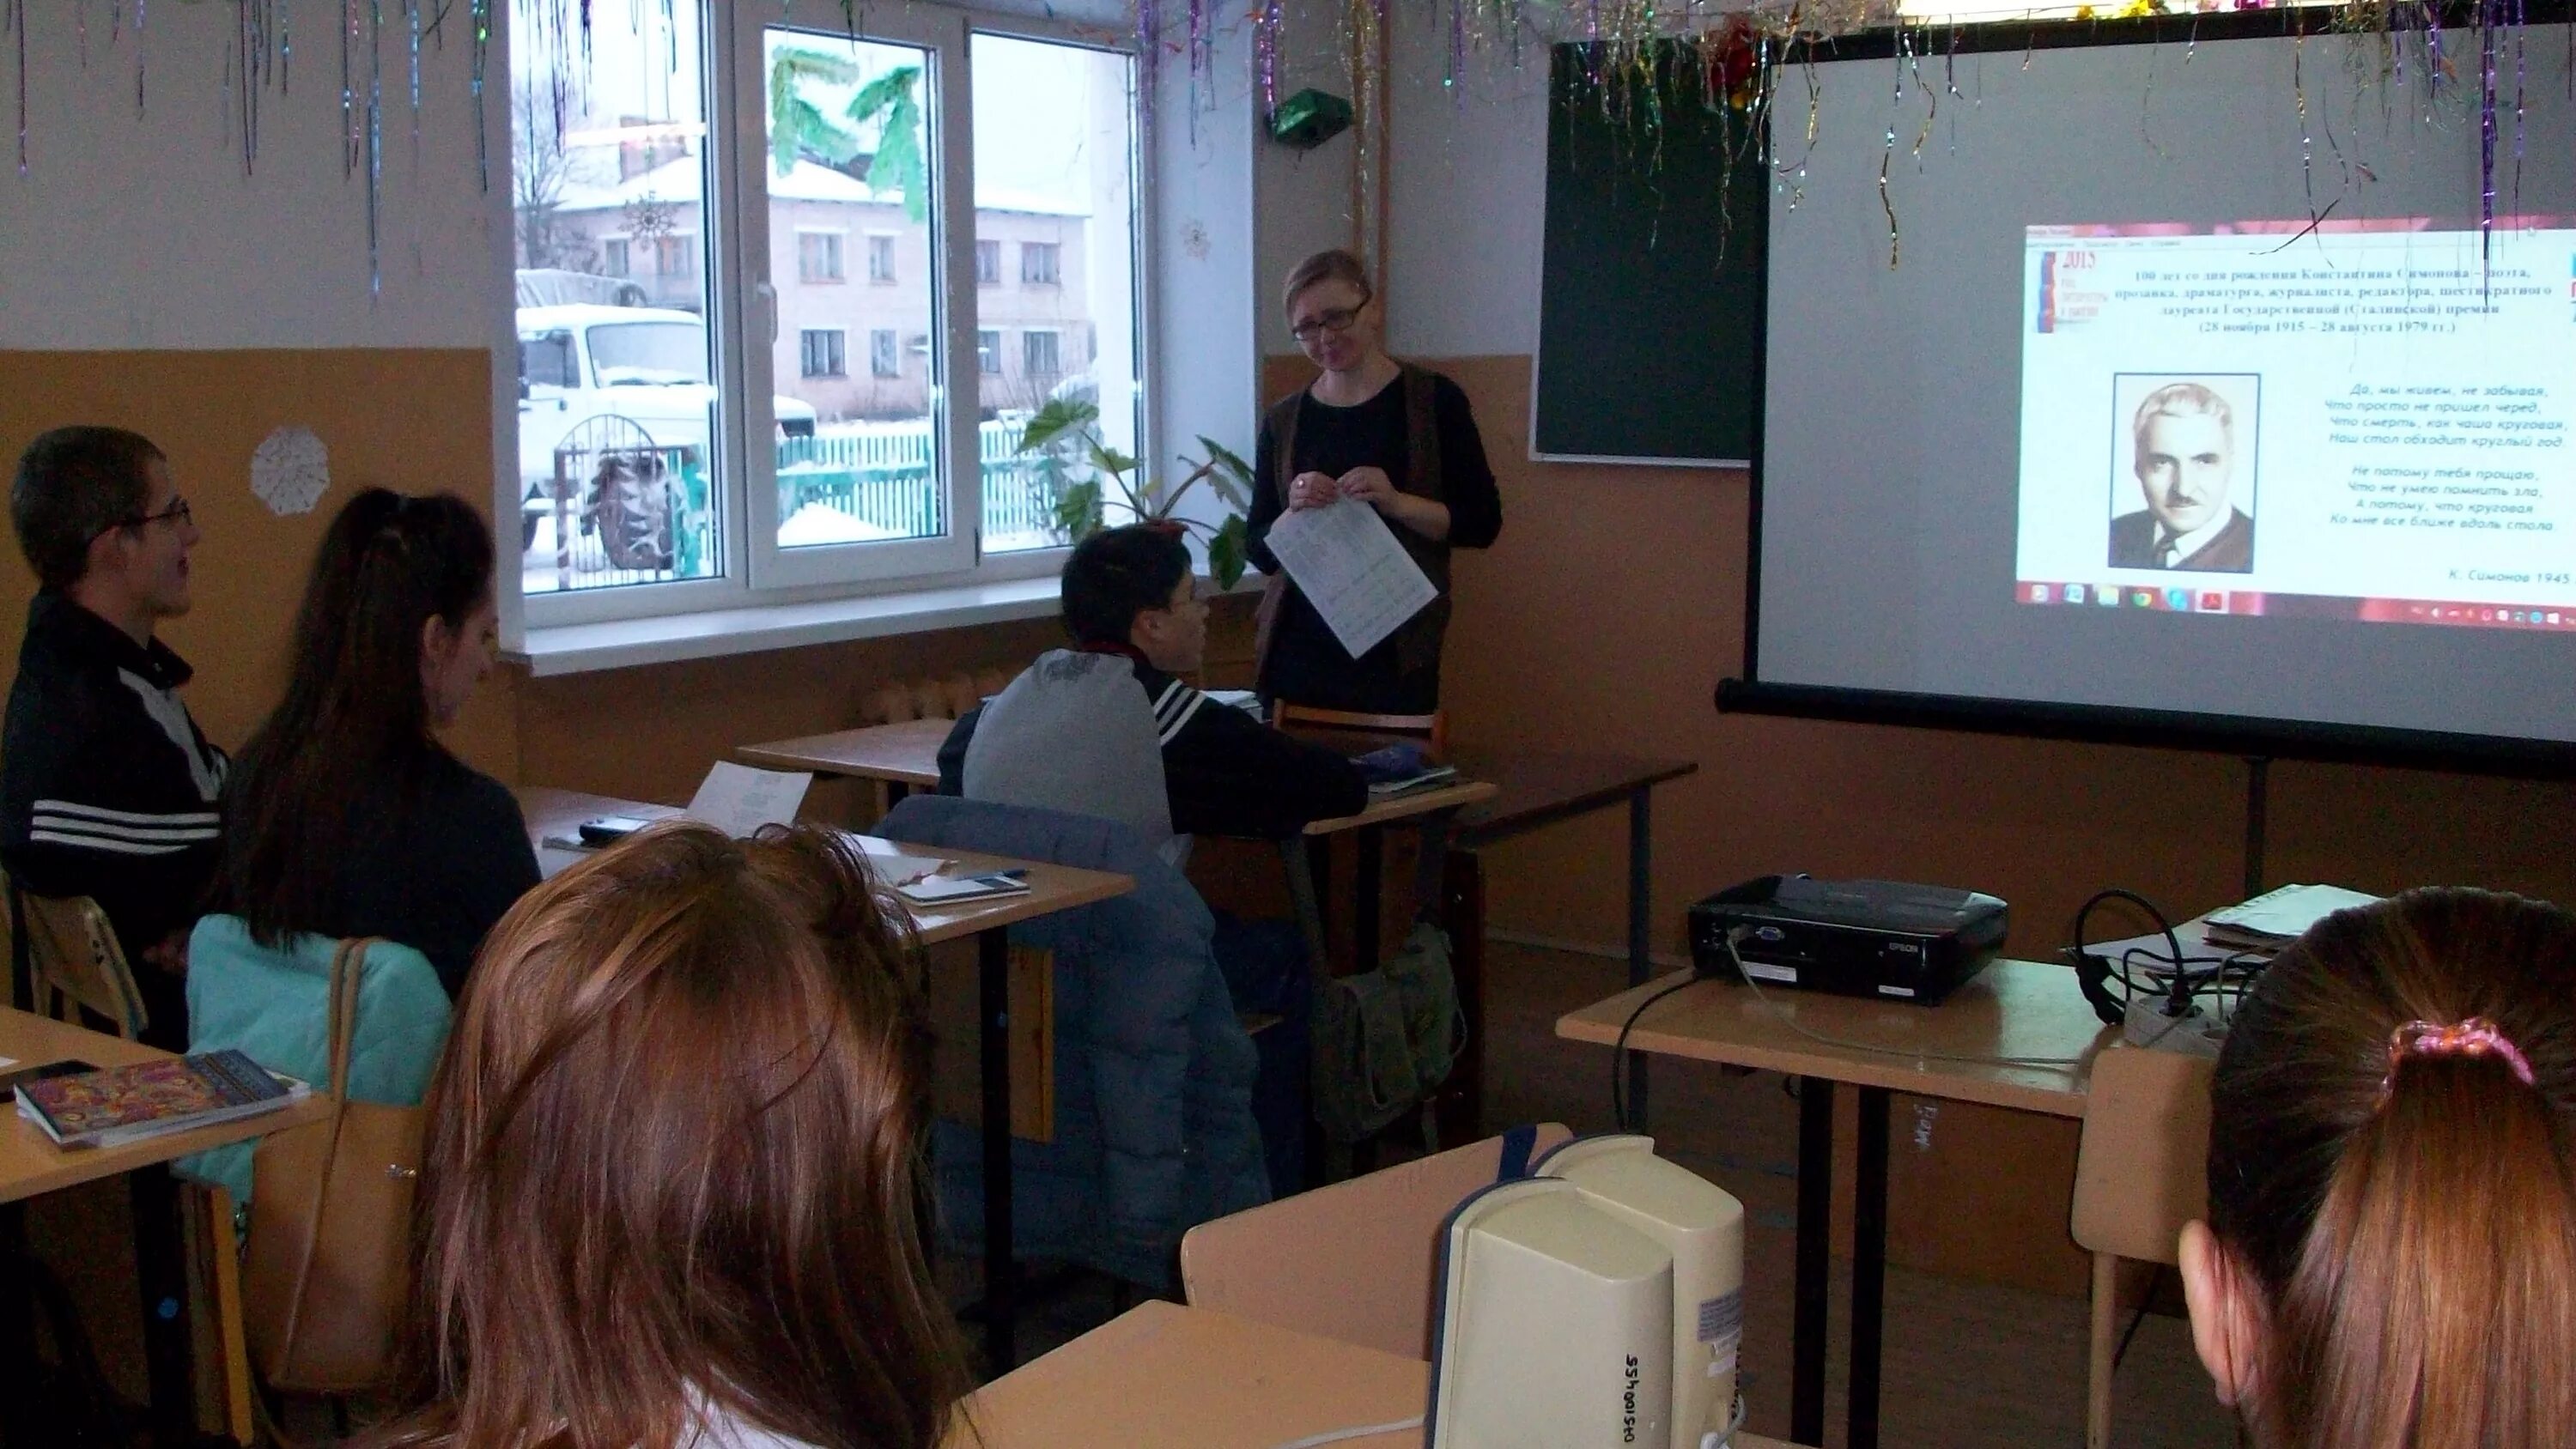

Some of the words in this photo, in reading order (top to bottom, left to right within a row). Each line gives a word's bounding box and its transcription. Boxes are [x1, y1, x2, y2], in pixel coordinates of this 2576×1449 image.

[2063, 251, 2095, 269] 2015
[2135, 271, 2156, 281] 100
[2301, 269, 2392, 280] Константина
[2397, 269, 2470, 278] Симонова
[2269, 288, 2354, 299] журналиста,
[2359, 288, 2434, 299] редактора,
[2224, 304, 2340, 317] Государственной
[2223, 322, 2270, 334] ноября
[2275, 321, 2305, 331] 1915
[2321, 321, 2336, 331] 28
[2340, 324, 2391, 335] августа
[2398, 321, 2428, 332] 1979
[2483, 385, 2549, 397] забывая,
[2324, 399, 2353, 410] Что
[2357, 403, 2409, 413] просто
[2330, 416, 2358, 426] Что
[2362, 419, 2421, 429] смерть,
[2427, 419, 2450, 427] как
[2457, 420, 2492, 428] чаша
[2497, 421, 2567, 433] круговая,
[2329, 433, 2359, 443] Наш
[2363, 435, 2399, 444] стол
[2403, 433, 2466, 445] обходит
[2472, 435, 2532, 448] круглый
[2352, 465, 2369, 476] Не
[2374, 469, 2429, 480] потому
[2434, 467, 2471, 477] тебя
[2476, 470, 2539, 482] прощаю,
[2348, 481, 2376, 492] Что
[2402, 485, 2439, 495] умею
[2443, 486, 2508, 496] помнить
[2513, 488, 2543, 498] зло,
[2355, 499, 2364, 507] А
[2369, 500, 2429, 512] потому,
[2435, 503, 2464, 512] что
[2469, 504, 2534, 515] круговая
[2330, 513, 2348, 524] Ко
[2383, 517, 2405, 525] все
[2410, 516, 2455, 527] ближе
[2460, 518, 2501, 529] вдоль
[2468, 569, 2530, 583] Симонов
[2537, 573, 2570, 584] 1945
